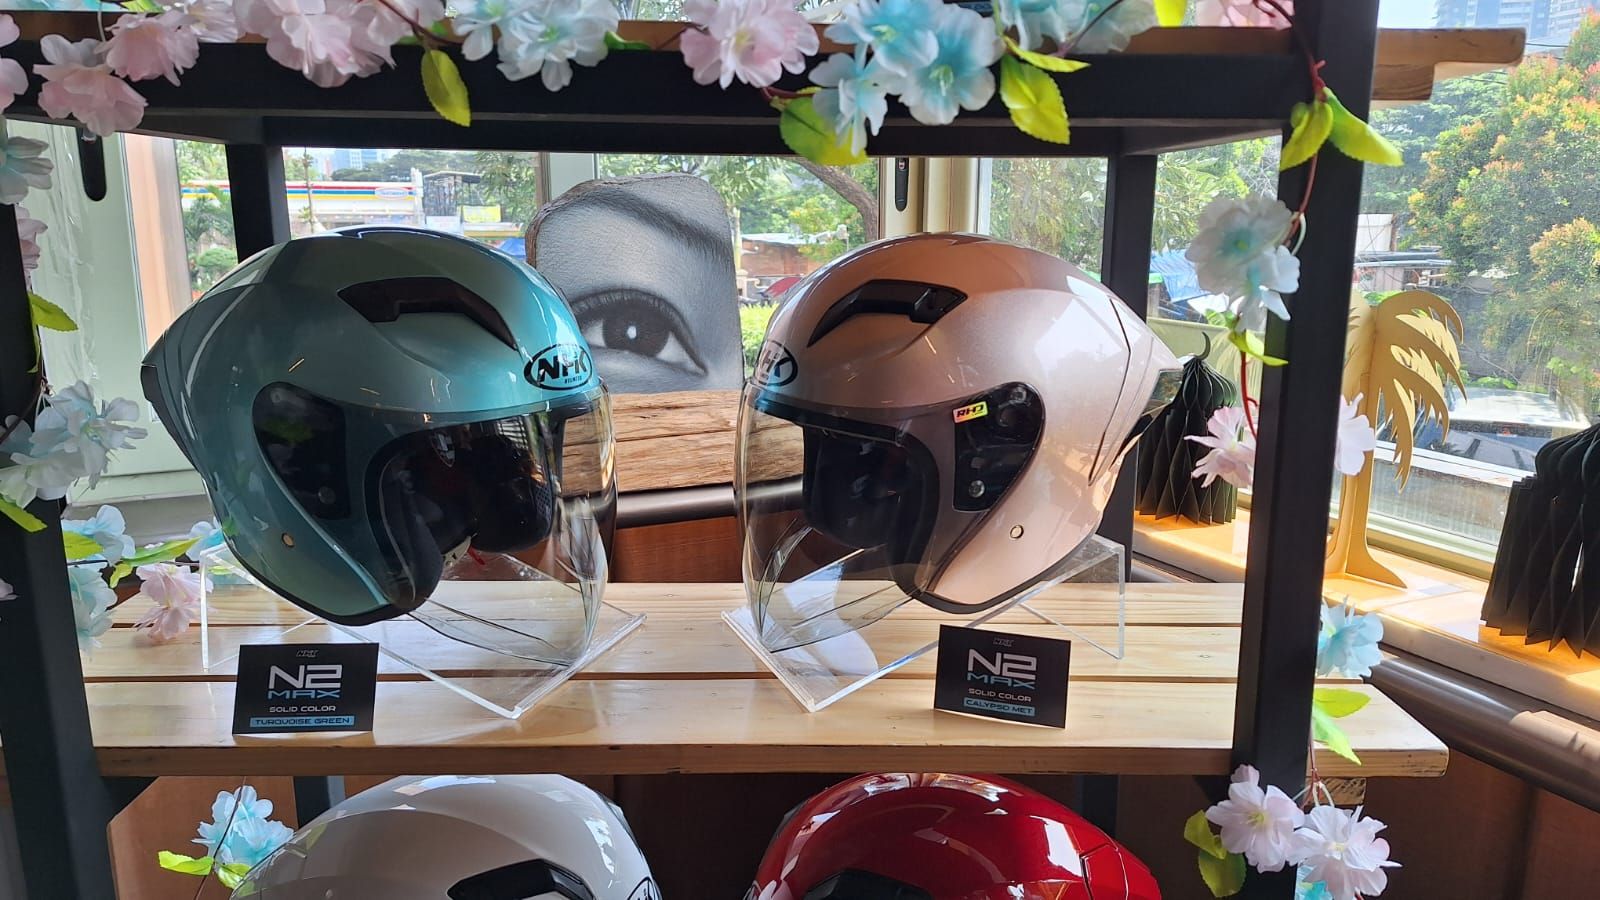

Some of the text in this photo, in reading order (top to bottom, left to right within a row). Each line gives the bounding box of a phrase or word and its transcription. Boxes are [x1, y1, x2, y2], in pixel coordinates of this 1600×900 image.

[967, 648, 1037, 680] N2
[268, 664, 342, 689] N2
[967, 672, 1035, 690] MAX
[267, 689, 340, 699] MAX
[968, 688, 1031, 702] SOLID COLOR
[269, 705, 298, 713] SOLID
[966, 699, 1033, 714] CALYPSO MET
